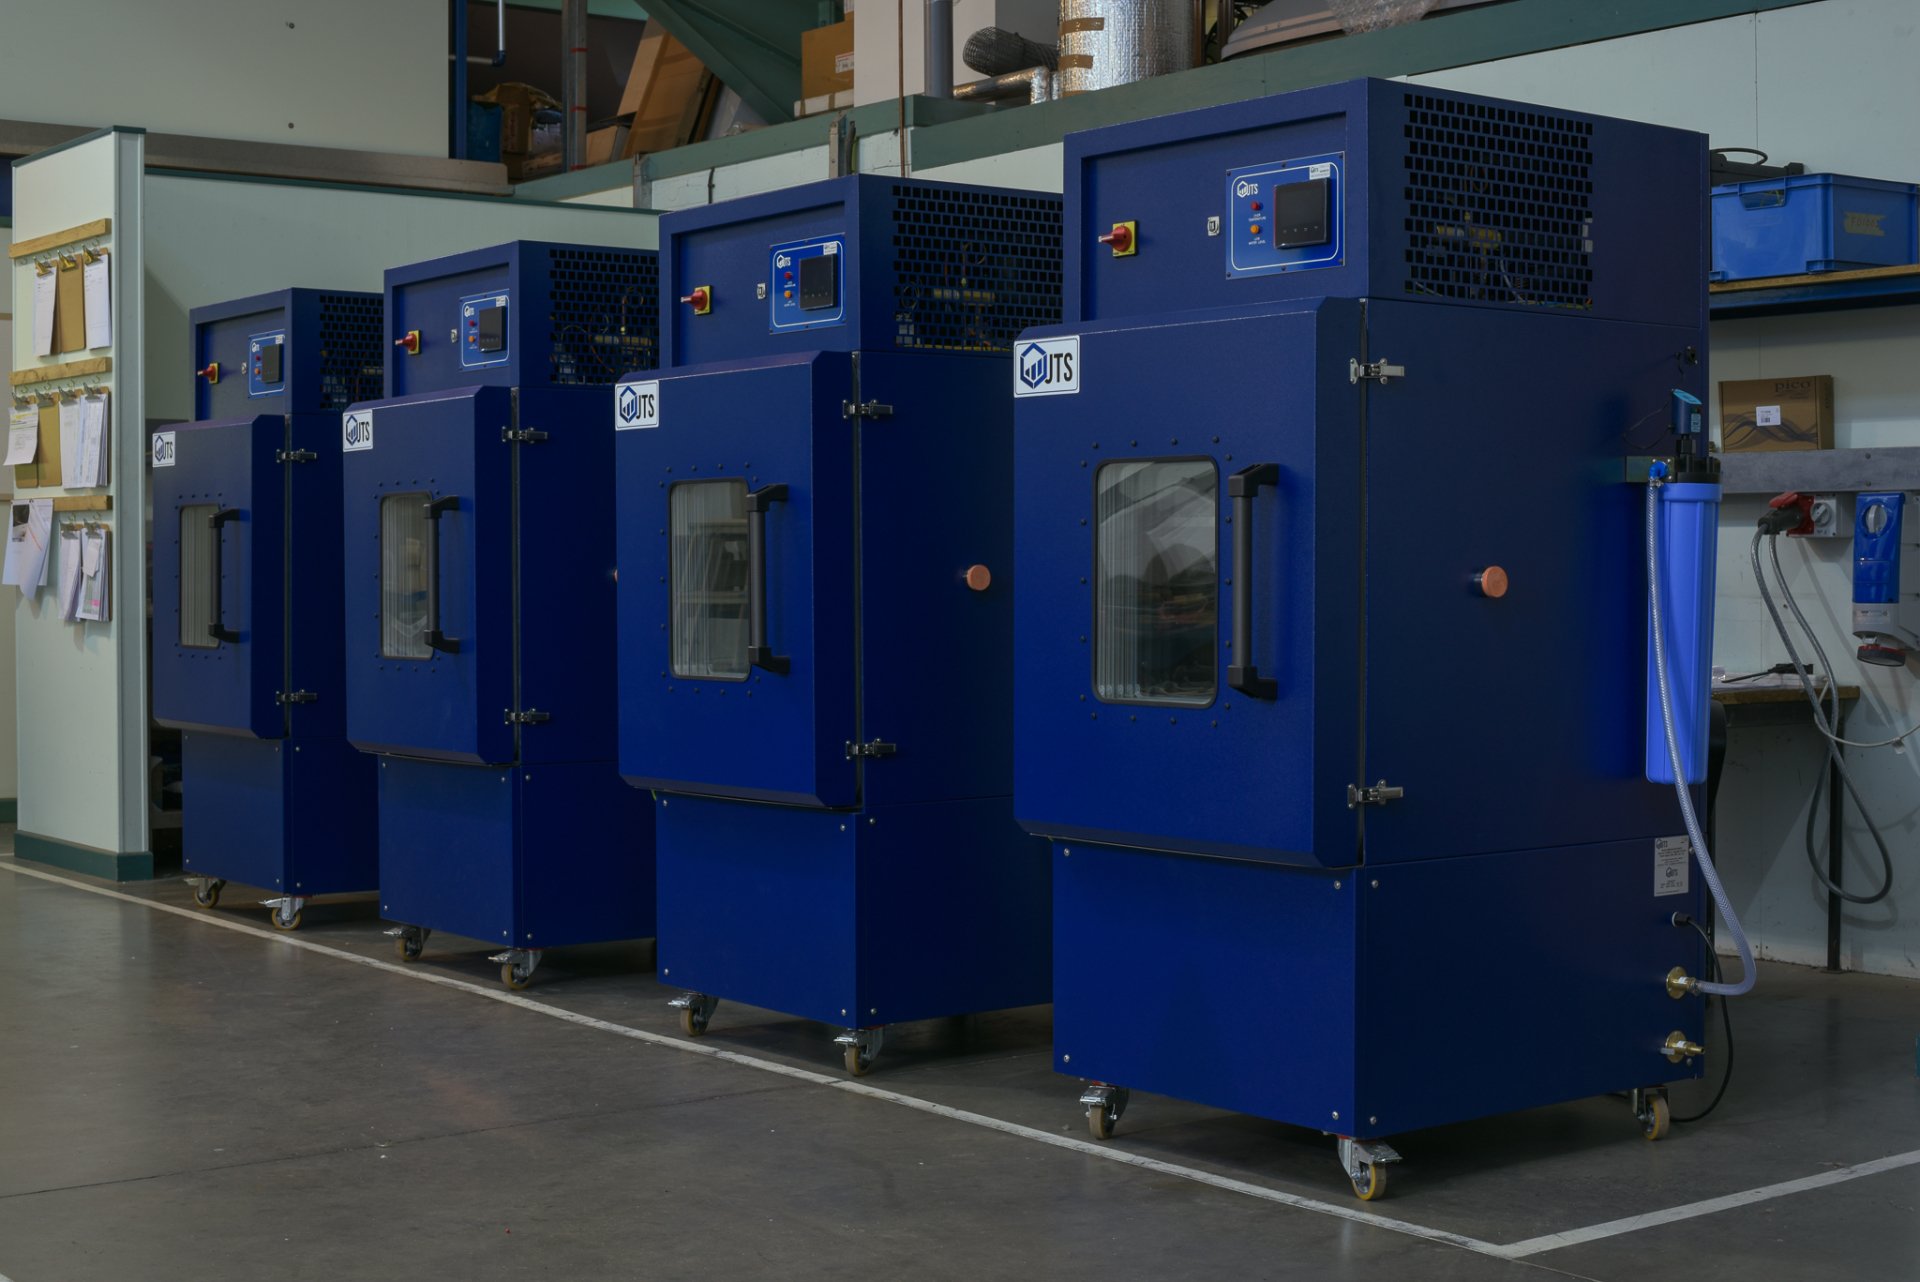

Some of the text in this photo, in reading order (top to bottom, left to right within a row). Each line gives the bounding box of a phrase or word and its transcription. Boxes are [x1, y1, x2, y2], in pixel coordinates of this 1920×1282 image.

[1044, 352, 1073, 384] JTS
[636, 394, 655, 419] JTS
[357, 421, 370, 443] JTS
[163, 441, 174, 460] JTS
